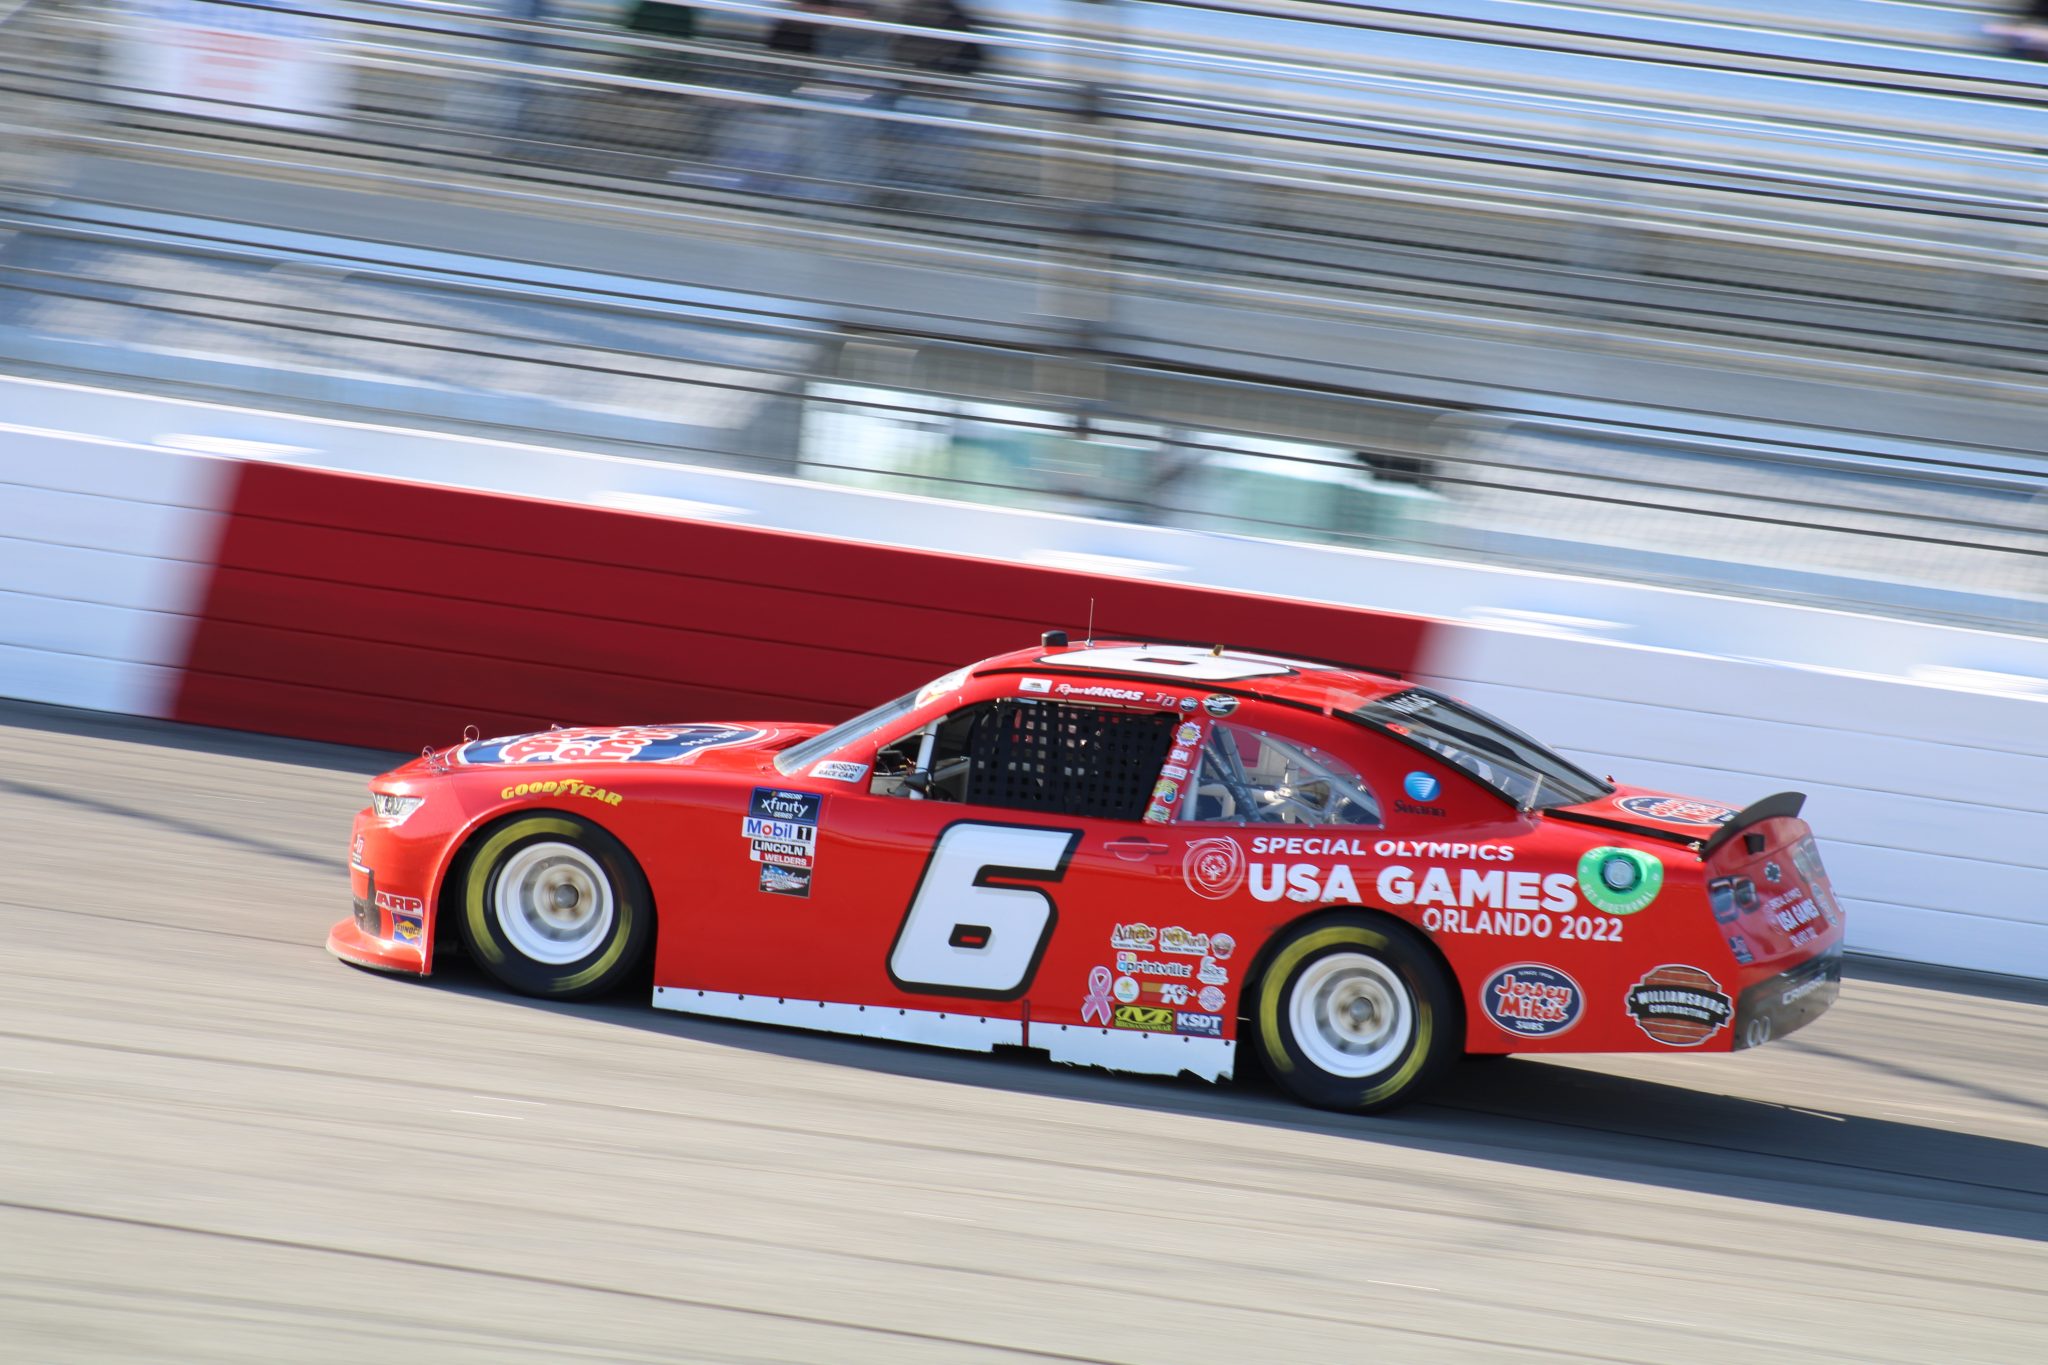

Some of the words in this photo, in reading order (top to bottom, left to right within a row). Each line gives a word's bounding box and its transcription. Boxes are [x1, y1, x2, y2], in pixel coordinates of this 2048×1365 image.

[1083, 686, 1144, 701] VARGAS
[501, 779, 623, 806] GOODYEAR
[761, 798, 808, 817] xfinity
[1394, 800, 1446, 816] Swann
[747, 819, 793, 839] Mobil
[754, 840, 804, 856] LINCOLN
[1251, 836, 1366, 856] SPECIAL
[1374, 840, 1515, 862] OLYMPICS
[764, 853, 807, 866] WELDERS
[1249, 863, 1363, 903] USA
[1376, 865, 1578, 912] GAMES
[376, 891, 423, 914] ARP
[887, 819, 1083, 1001] 6
[1423, 908, 1552, 938] ORLANDO
[1559, 915, 1623, 942] 2022
[1495, 974, 1572, 1008] Jersey
[1177, 1012, 1222, 1029] KSDT
